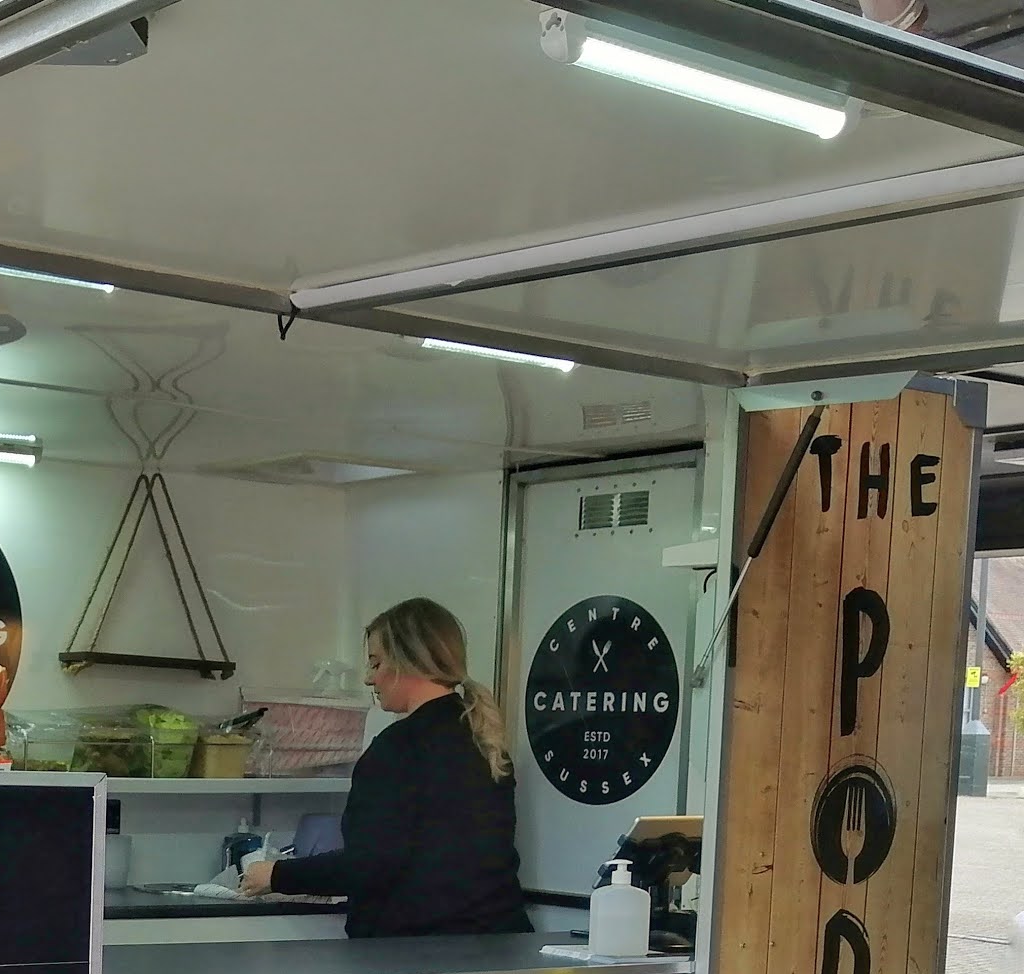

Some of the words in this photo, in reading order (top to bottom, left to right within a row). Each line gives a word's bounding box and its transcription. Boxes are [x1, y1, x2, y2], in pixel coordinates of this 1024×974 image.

[809, 434, 940, 520] THE
[549, 606, 659, 652] CENTRE
[533, 691, 670, 713] CATERING
[584, 731, 611, 742] ESTD
[582, 749, 609, 760] 2017
[544, 750, 652, 794] SUSSEX
